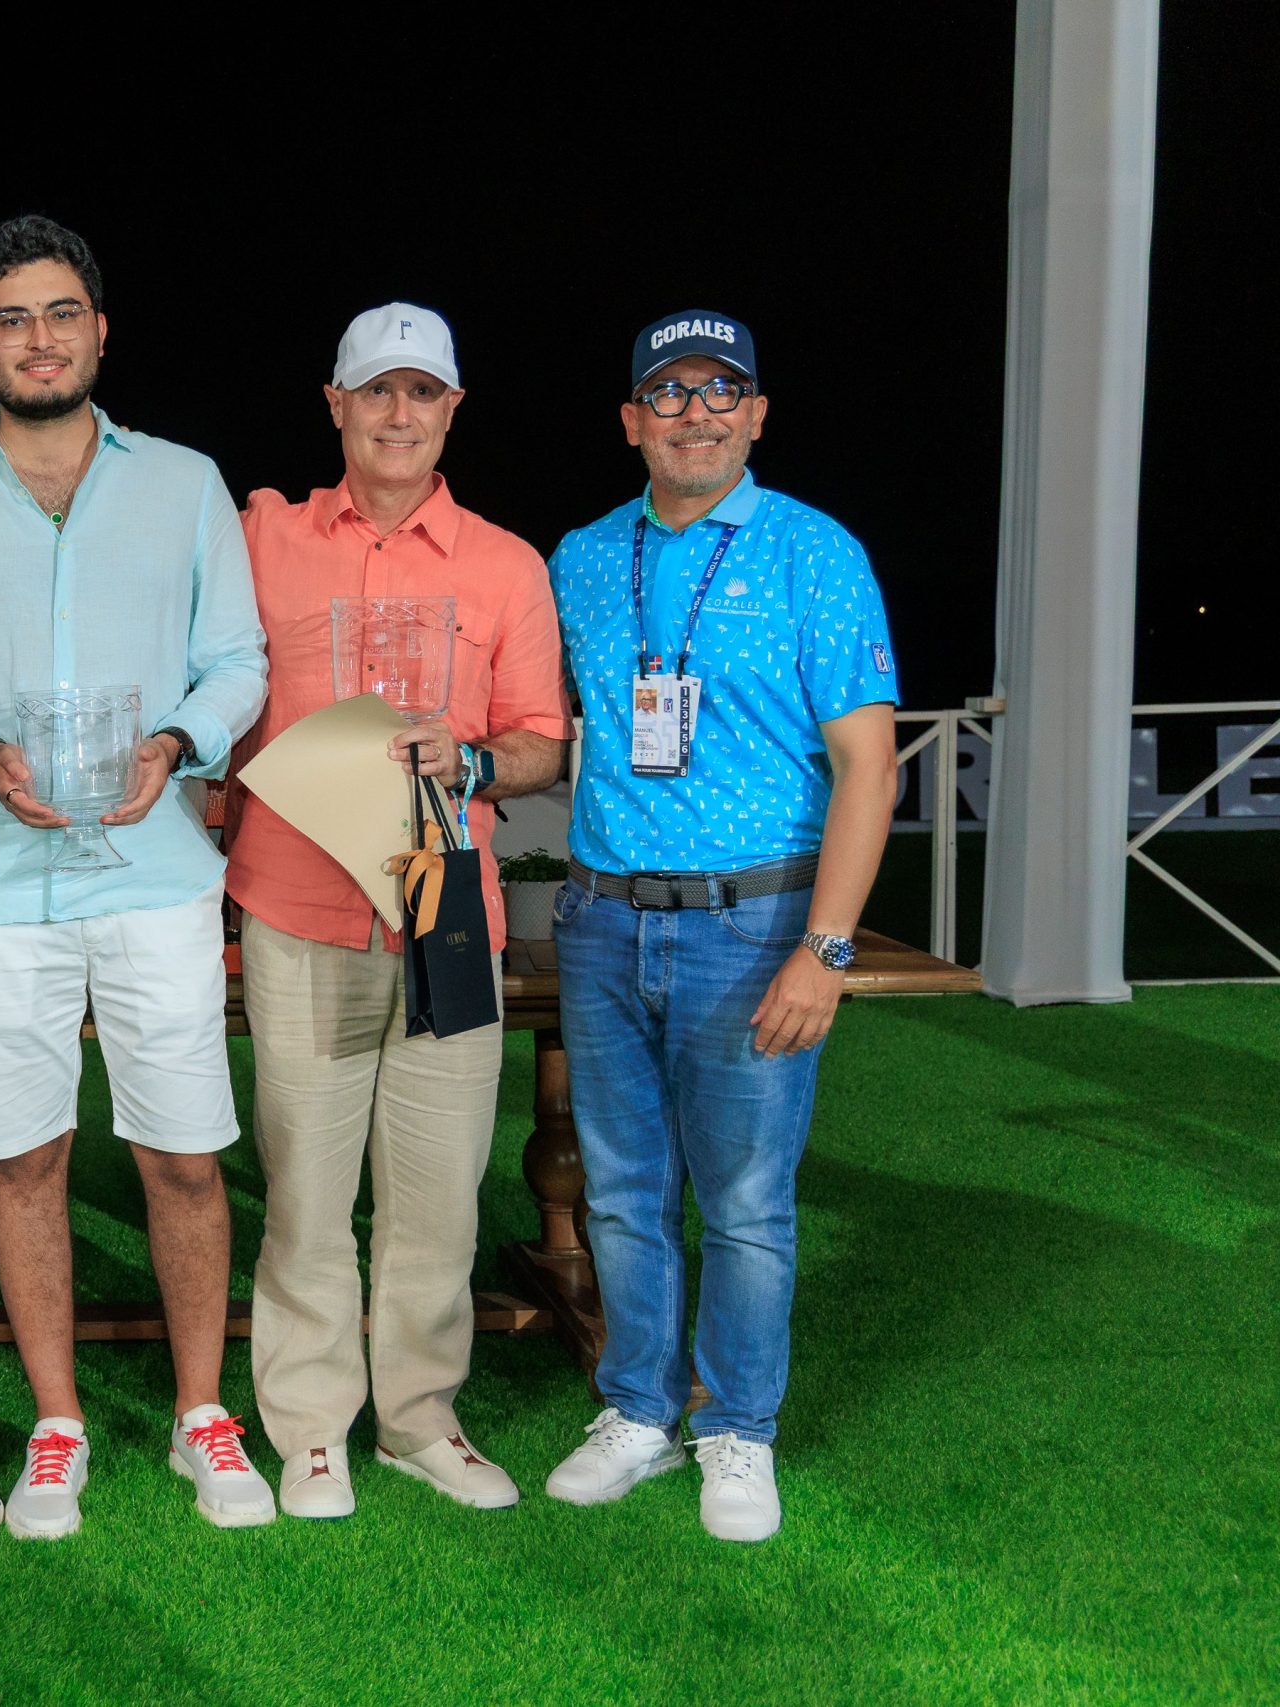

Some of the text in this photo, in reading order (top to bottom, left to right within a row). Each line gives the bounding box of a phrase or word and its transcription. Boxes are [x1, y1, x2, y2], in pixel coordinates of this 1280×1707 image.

[650, 319, 735, 350] CORALES
[705, 598, 761, 610] CORALES
[682, 688, 688, 696] 1
[682, 699, 689, 708] 2
[682, 711, 688, 720] 3
[682, 722, 688, 731] 4
[682, 733, 688, 743] 5
[681, 745, 688, 754] 6
[681, 767, 687, 777] 8
